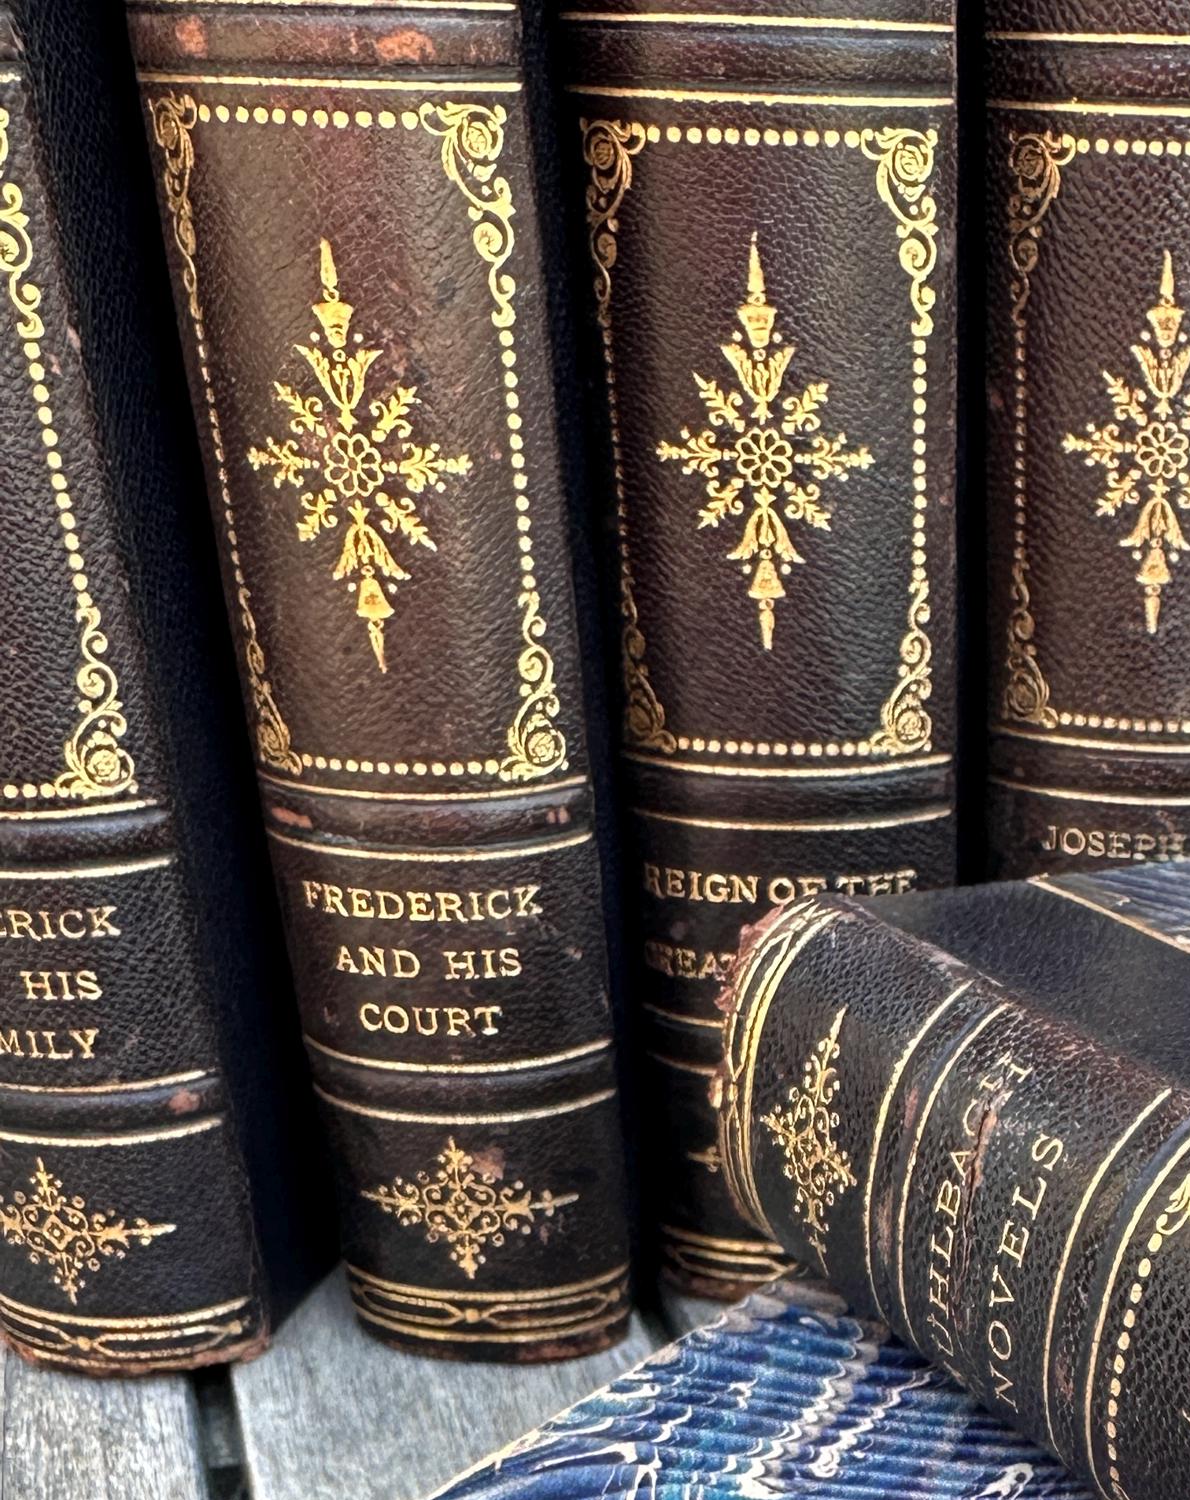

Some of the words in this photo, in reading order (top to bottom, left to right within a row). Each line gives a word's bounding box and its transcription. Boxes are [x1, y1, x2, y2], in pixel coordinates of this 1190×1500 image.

[1041, 825, 1189, 862] JOSEPH
[644, 862, 760, 904] REIGN
[768, 874, 828, 904] OF
[301, 880, 544, 924] FREDERICK
[0, 905, 122, 942] RICK
[336, 945, 421, 979] AND
[443, 947, 523, 980] HIS
[19, 970, 103, 1001] HIS
[359, 1002, 503, 1039] COURT
[987, 1132, 1064, 1414] NOVELS
